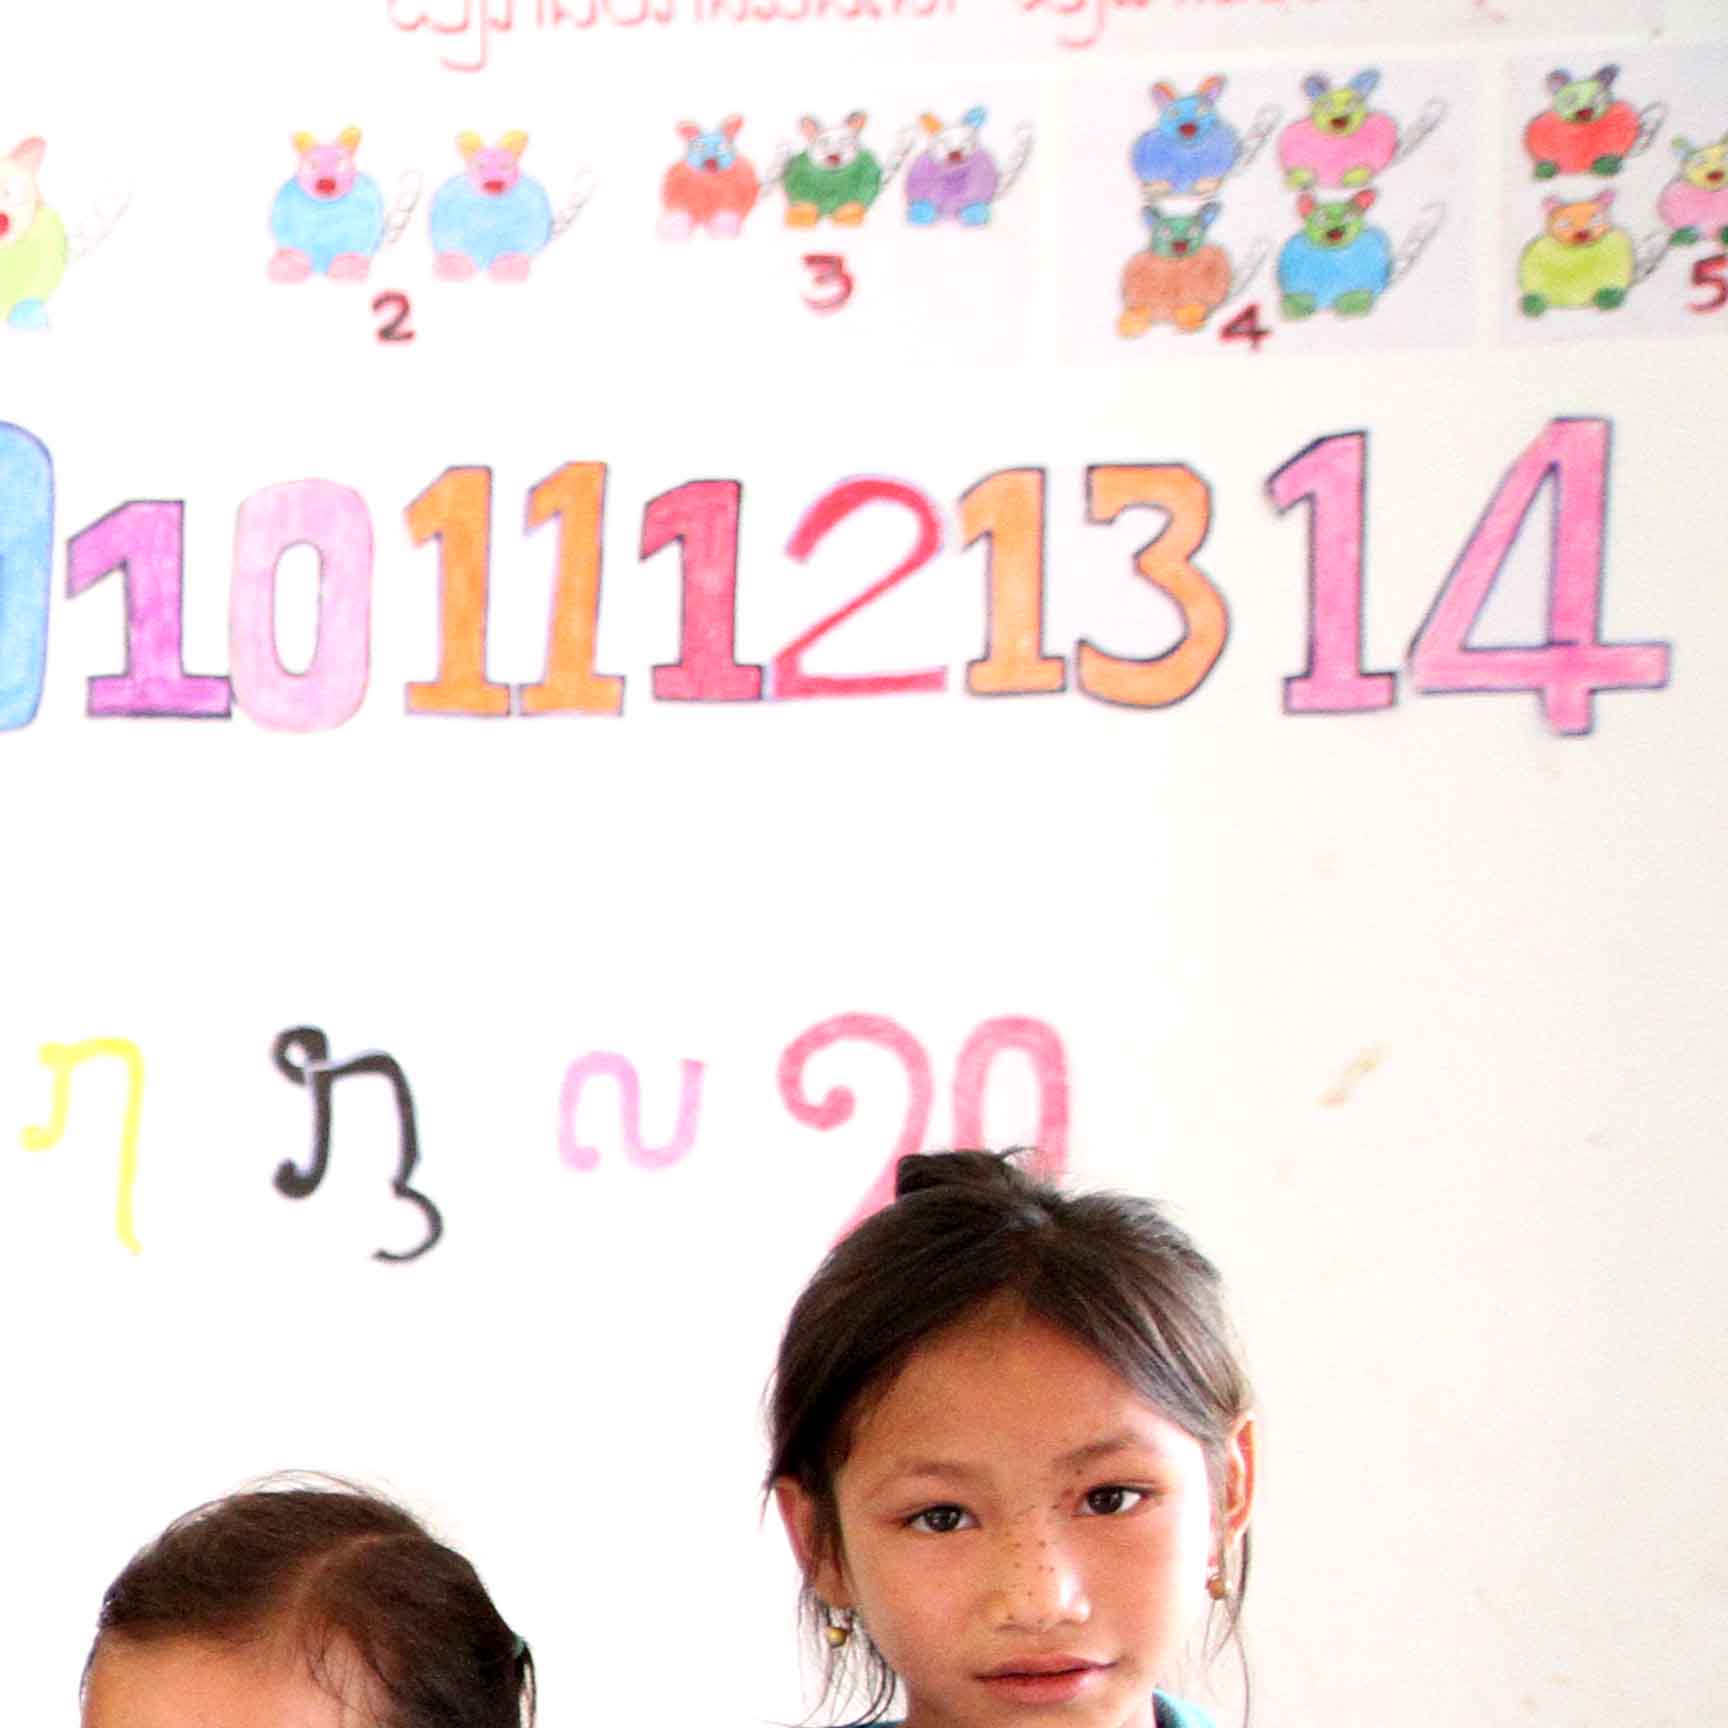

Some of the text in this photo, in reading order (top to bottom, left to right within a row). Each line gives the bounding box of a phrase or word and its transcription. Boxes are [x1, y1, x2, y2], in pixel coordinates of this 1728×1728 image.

[803, 253, 854, 312] 3
[1687, 252, 1728, 316] 5
[372, 291, 415, 344] 2
[1219, 303, 1271, 351] 4
[64, 478, 376, 734] 10
[403, 460, 627, 719] 11
[638, 474, 949, 706] 12
[958, 462, 1234, 712] 13
[1264, 416, 1671, 738] 14
